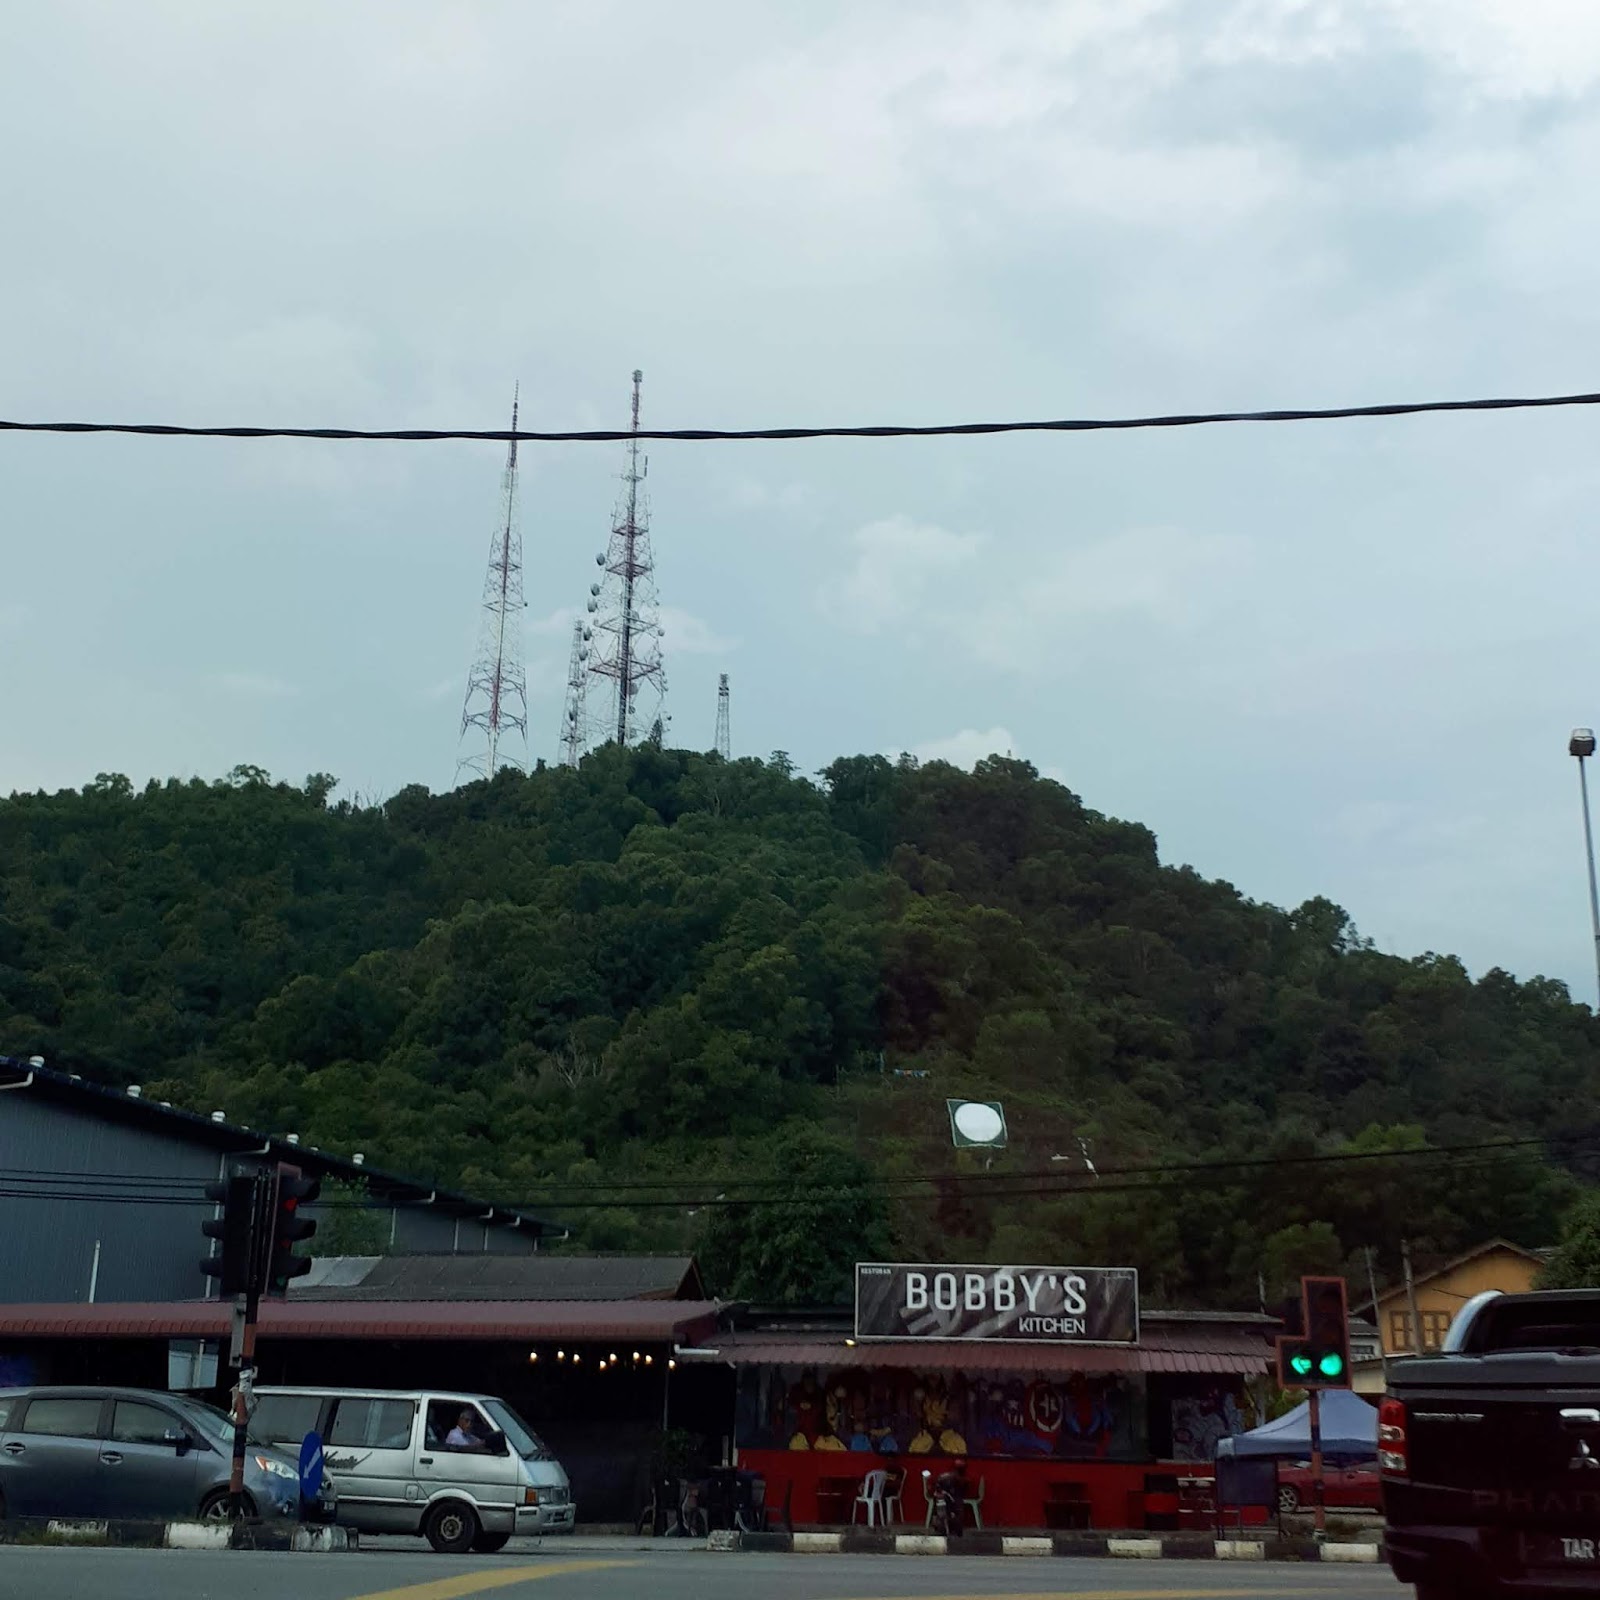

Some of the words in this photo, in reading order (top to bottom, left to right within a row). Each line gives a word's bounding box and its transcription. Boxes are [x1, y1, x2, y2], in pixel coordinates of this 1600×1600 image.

[906, 1272, 1087, 1314] BOBBY'S
[1018, 1316, 1086, 1334] KITCHEN
[1560, 1538, 1595, 1559] TAR
